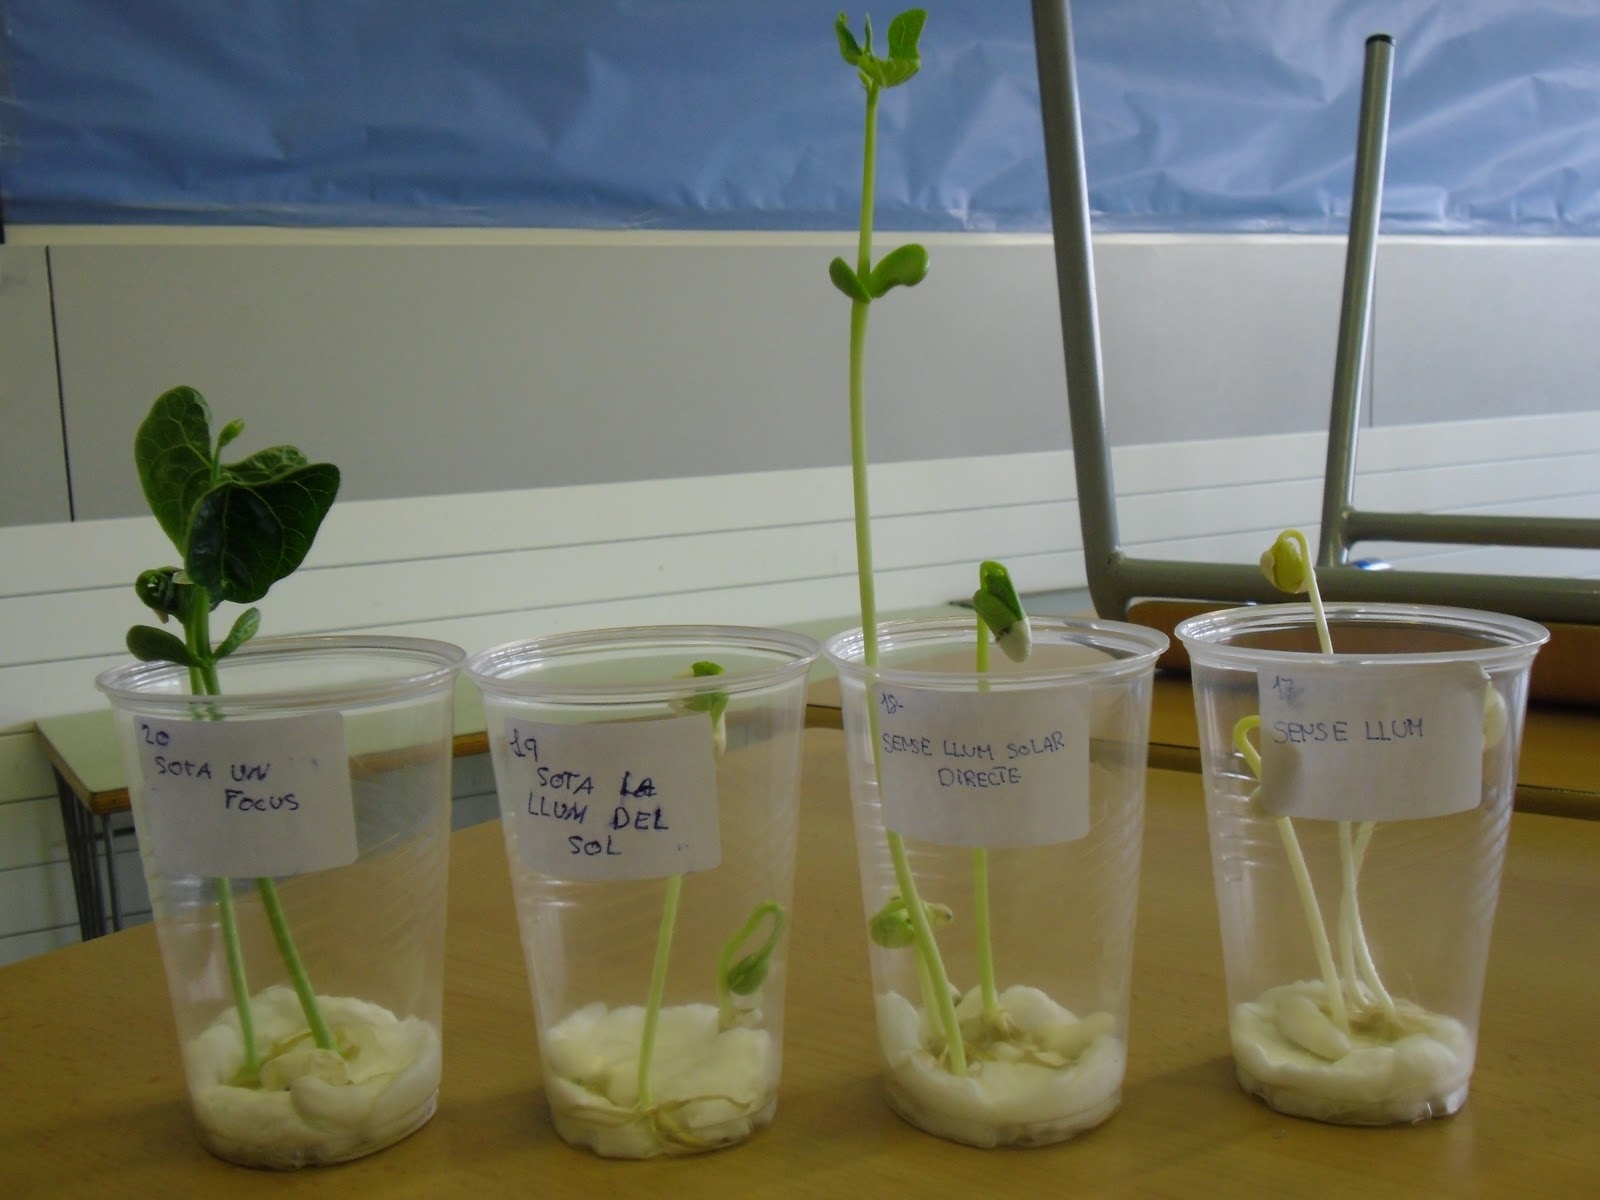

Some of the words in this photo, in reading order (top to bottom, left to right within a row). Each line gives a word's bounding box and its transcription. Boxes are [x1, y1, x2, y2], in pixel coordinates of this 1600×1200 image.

[142, 724, 169, 746] 20
[1274, 721, 1347, 744] SENSE
[1365, 718, 1423, 741] LLUM
[509, 729, 538, 761] 19
[883, 733, 932, 756] SENSE
[944, 740, 994, 760] LLUM
[1007, 731, 1065, 759] SOLAR
[154, 756, 212, 779] SOTA
[231, 763, 270, 781] UN
[537, 767, 594, 794] SOTA
[620, 771, 657, 797] LA
[528, 792, 587, 824] LLUM
[611, 806, 669, 830] DEL
[568, 835, 622, 856] SOL
